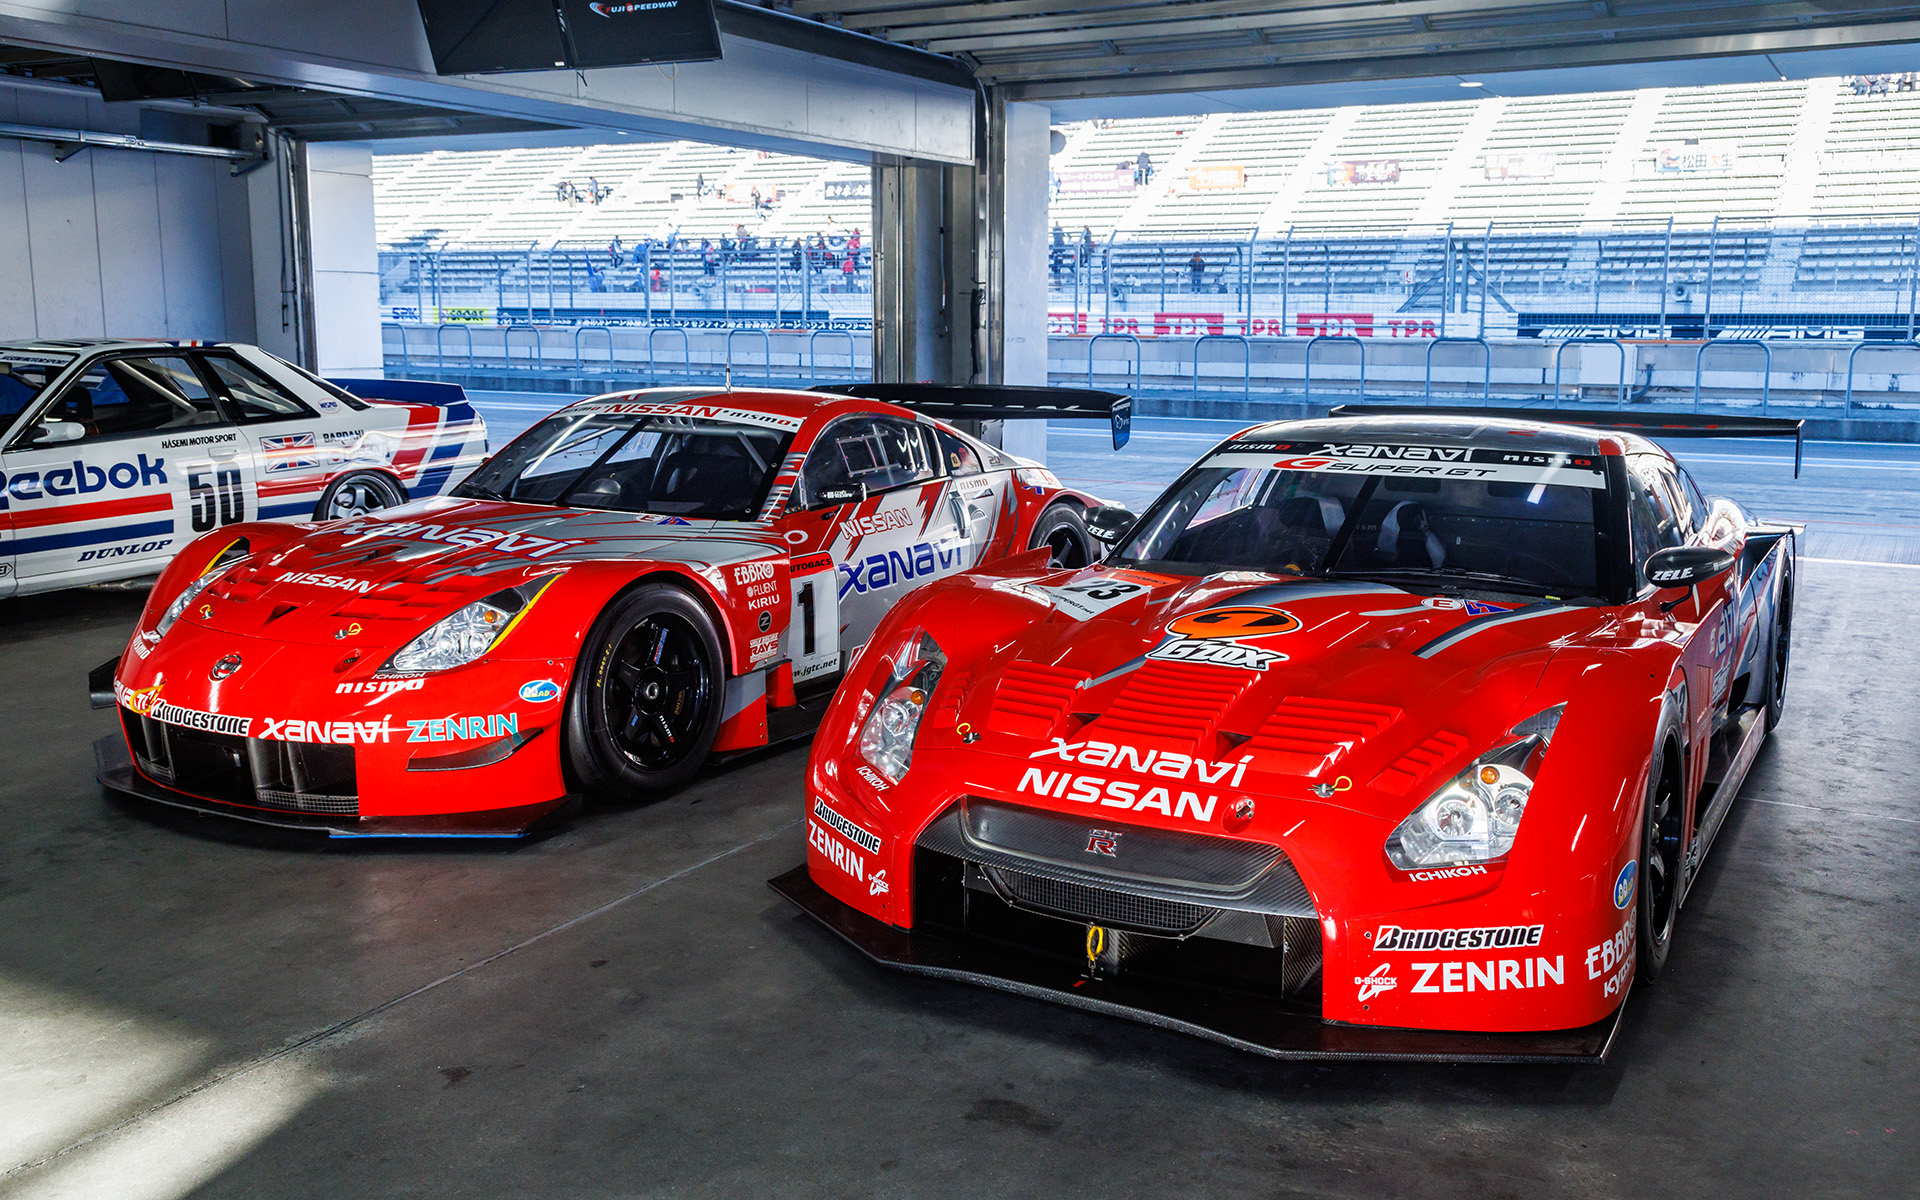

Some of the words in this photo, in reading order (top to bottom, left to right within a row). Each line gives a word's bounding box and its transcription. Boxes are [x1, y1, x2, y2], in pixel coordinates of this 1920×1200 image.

[626, 1, 678, 12] SPEEDWAY
[1099, 318, 1141, 334] TPR
[1387, 319, 1438, 337] TPR
[1758, 325, 1865, 340] AMG
[603, 403, 722, 418] NISSAN
[729, 411, 791, 427] nismo
[161, 437, 189, 449] HASEMI
[1326, 462, 1440, 475] SUPER
[1441, 467, 1498, 478] GT
[0, 454, 168, 509] eebok
[187, 463, 245, 532] 50
[839, 508, 914, 540] NISSAN
[1087, 524, 1115, 539] ZELE
[77, 539, 173, 562] DUNLOP
[734, 561, 774, 585] EBBRO
[790, 558, 831, 573] UTOBACS
[1652, 567, 1694, 581] ZELE
[274, 572, 379, 593] NISSAN
[1062, 580, 1141, 600] 23
[748, 594, 780, 610] KIRIU
[797, 581, 816, 657] 1
[751, 640, 778, 655] RAYS
[150, 697, 253, 737] BRIDGESTONE
[406, 713, 518, 743] ZENRIN
[855, 765, 890, 792] ICHIKOH
[1016, 767, 1218, 822] NISSAN
[814, 795, 882, 855] BRIDGESTONE
[808, 818, 864, 882] ZENRIN
[1408, 865, 1488, 882] ICHIKOH
[1373, 924, 1544, 951] BRIDGESTONE
[1585, 906, 1637, 980] EBBRO
[1354, 975, 1398, 986] G-SHOCK
[1410, 955, 1565, 993] ZENRIN
